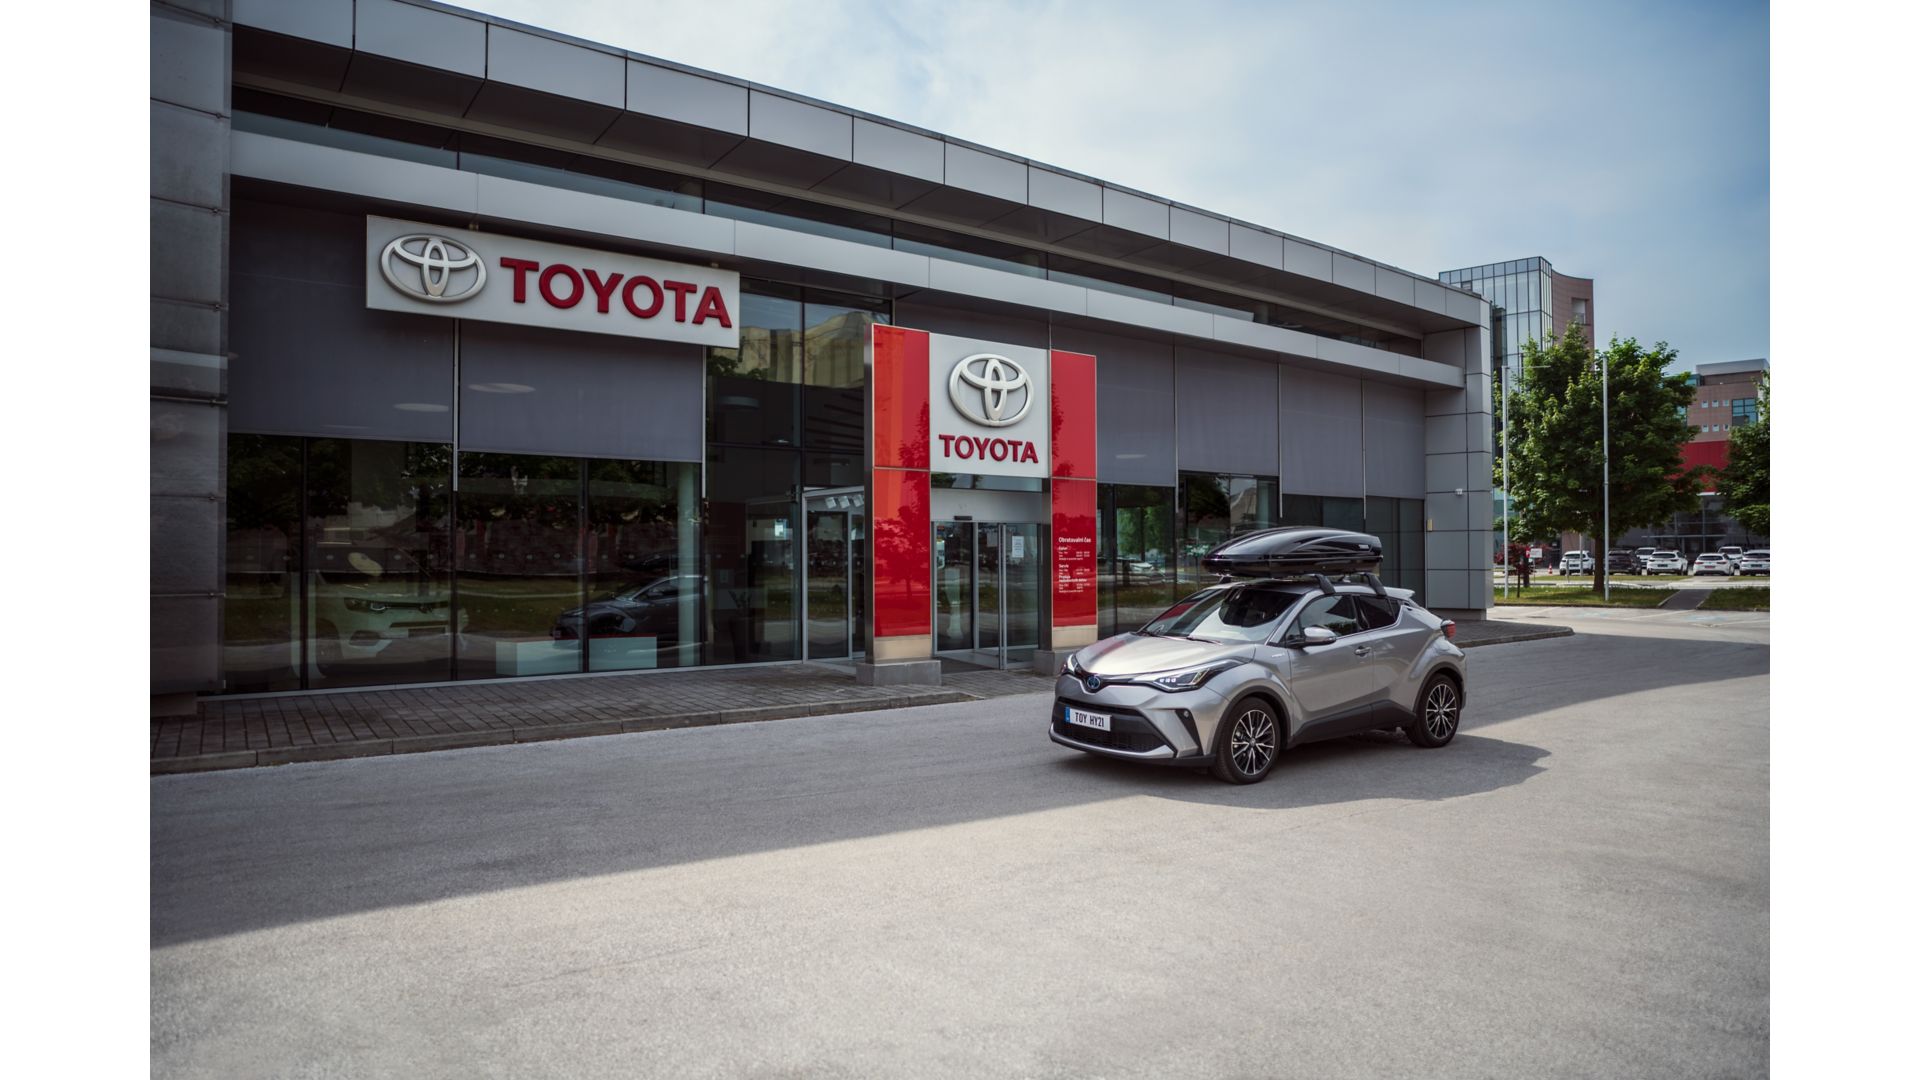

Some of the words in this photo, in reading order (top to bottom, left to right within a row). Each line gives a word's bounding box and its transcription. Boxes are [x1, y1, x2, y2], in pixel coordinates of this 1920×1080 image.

[500, 256, 732, 329] TOYOTA
[938, 433, 1039, 464] TOYOTA
[1075, 712, 1088, 723] TOY
